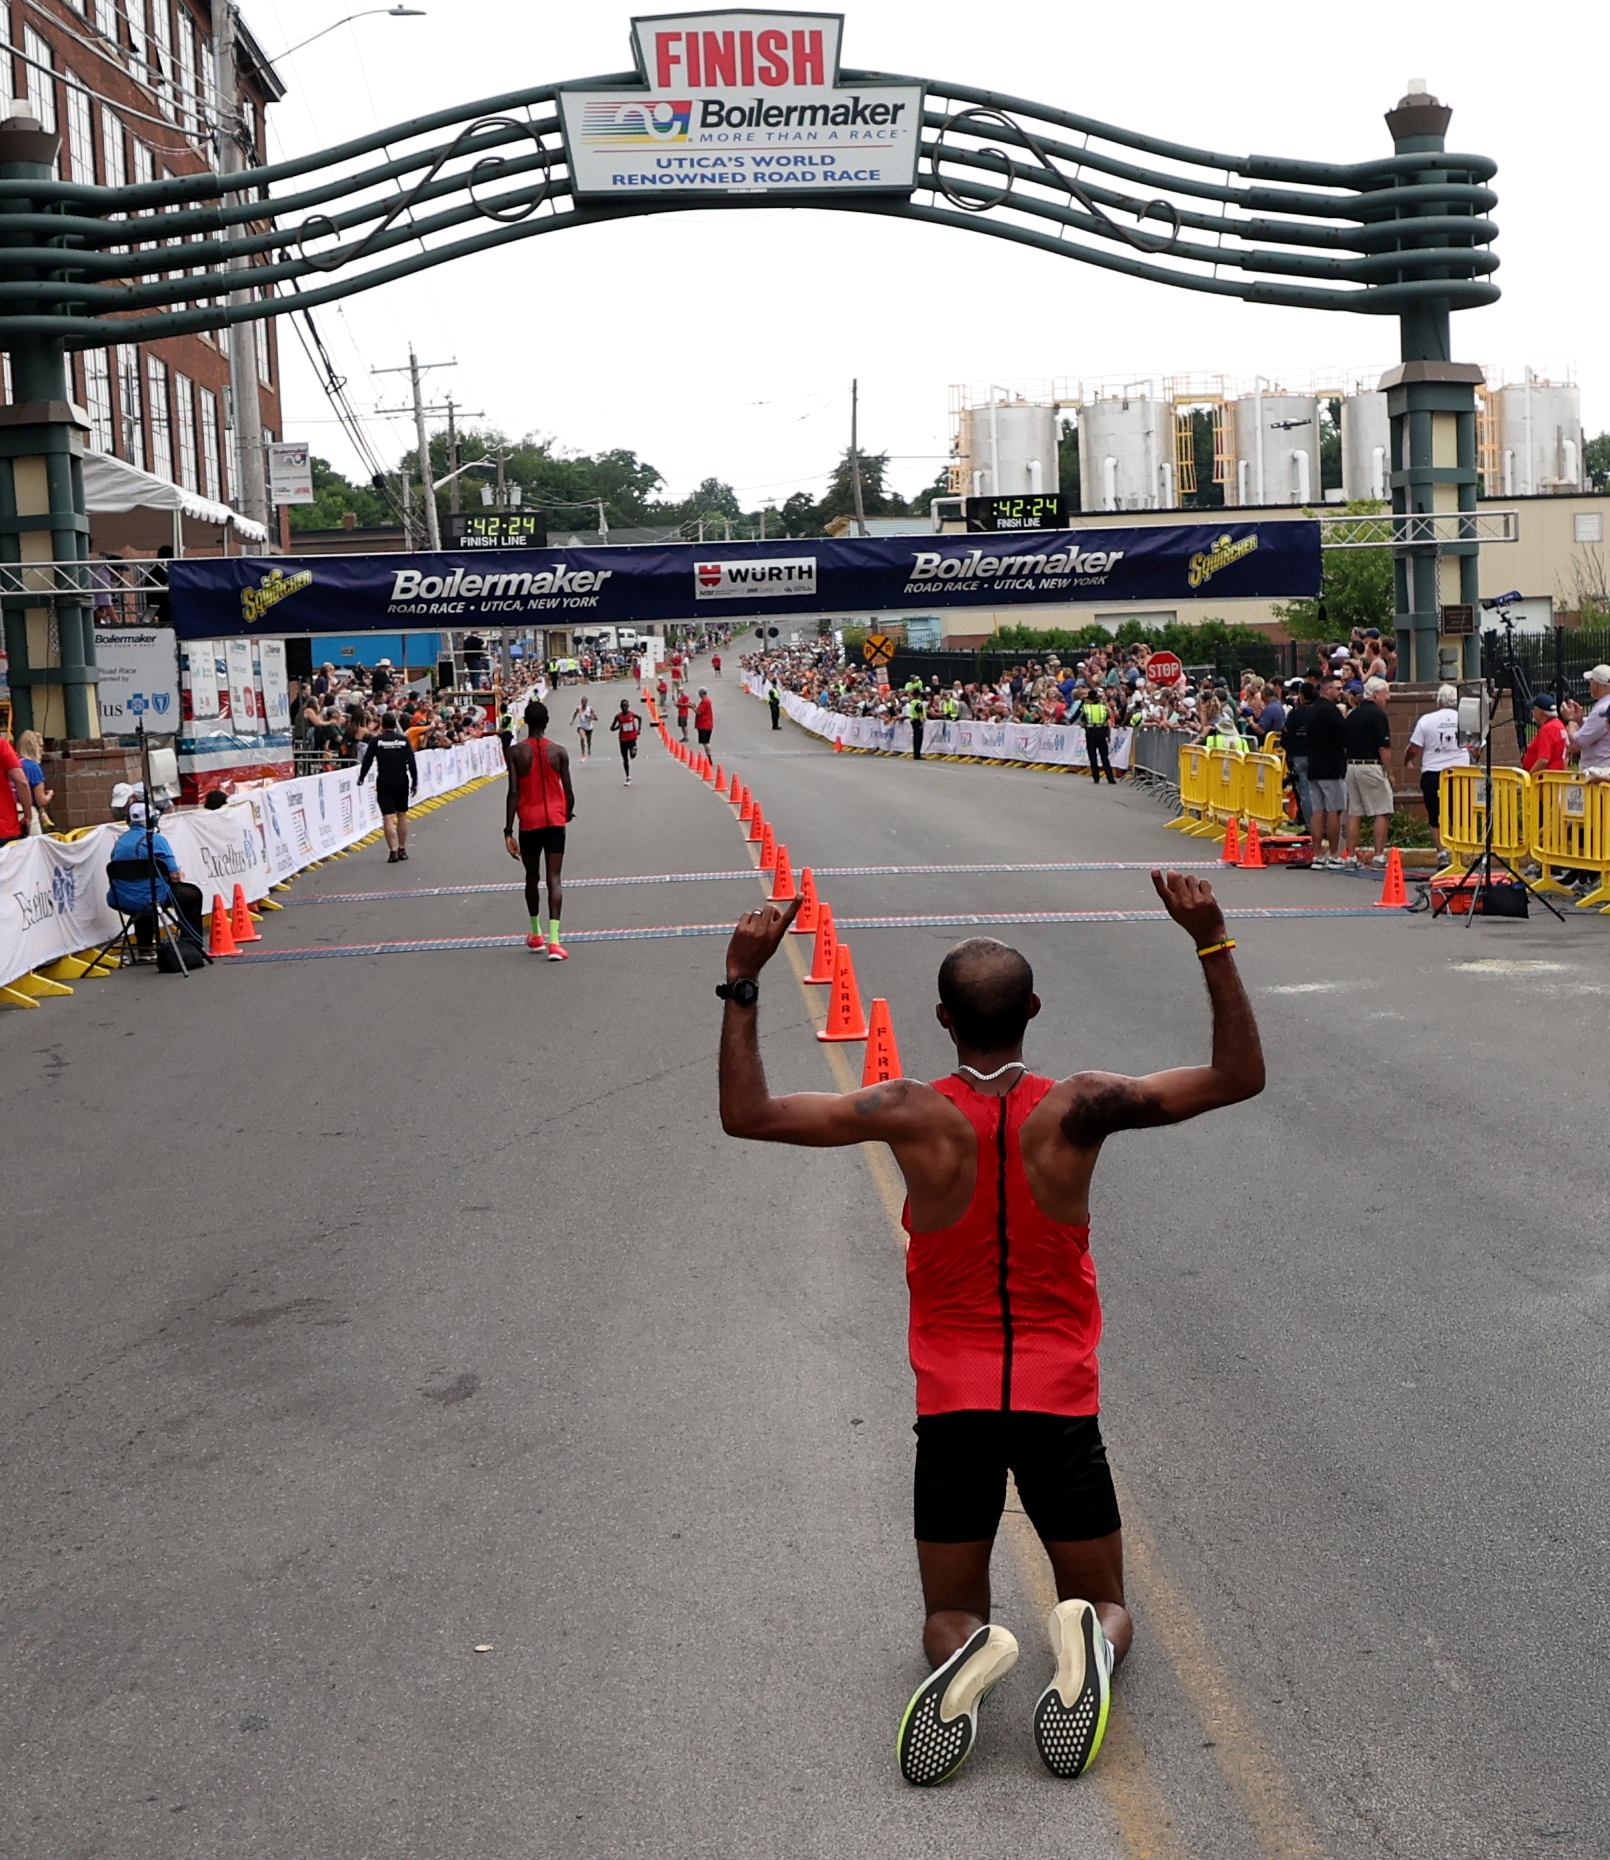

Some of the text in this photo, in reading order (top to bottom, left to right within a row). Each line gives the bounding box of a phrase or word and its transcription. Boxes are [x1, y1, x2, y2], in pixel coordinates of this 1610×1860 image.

[655, 29, 825, 88] FINISH
[697, 96, 905, 129] Boilermaker
[700, 129, 899, 142] MORE THAN A RACE
[656, 154, 836, 169] UTICA'S WORLD
[611, 169, 881, 186] RENOWNED ROAD RACE
[997, 517, 1041, 528] FINISH LINE
[460, 535, 527, 547] FINISH LINE
[911, 545, 1124, 580] Boilermaker
[391, 563, 613, 600] Boilermaker
[903, 575, 1109, 593] ROAD RACE UTICA, NEW YORK
[387, 596, 600, 614] ROAD RACE UTICA, NEW YORK
[865, 646, 872, 655] R
[1148, 662, 1180, 679] STOP
